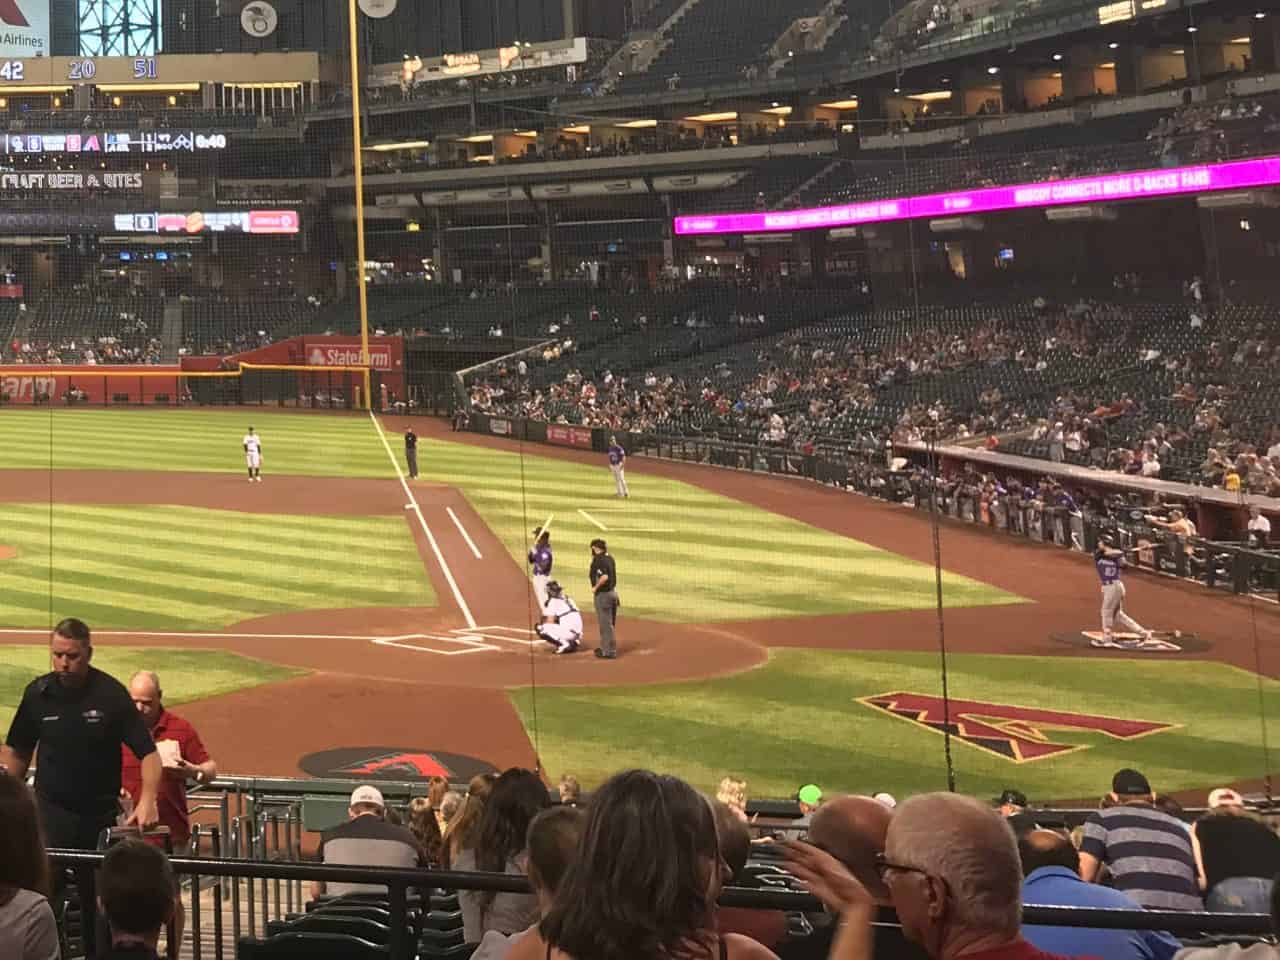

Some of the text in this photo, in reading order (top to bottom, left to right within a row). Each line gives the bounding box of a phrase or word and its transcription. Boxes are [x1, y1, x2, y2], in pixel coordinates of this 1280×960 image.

[4, 32, 44, 48] Airlines
[0, 61, 24, 80] 42
[69, 60, 96, 79] 20
[133, 59, 158, 79] 51
[1, 173, 45, 189] CRAFT
[48, 173, 83, 189] BEER
[103, 173, 142, 189] BITES
